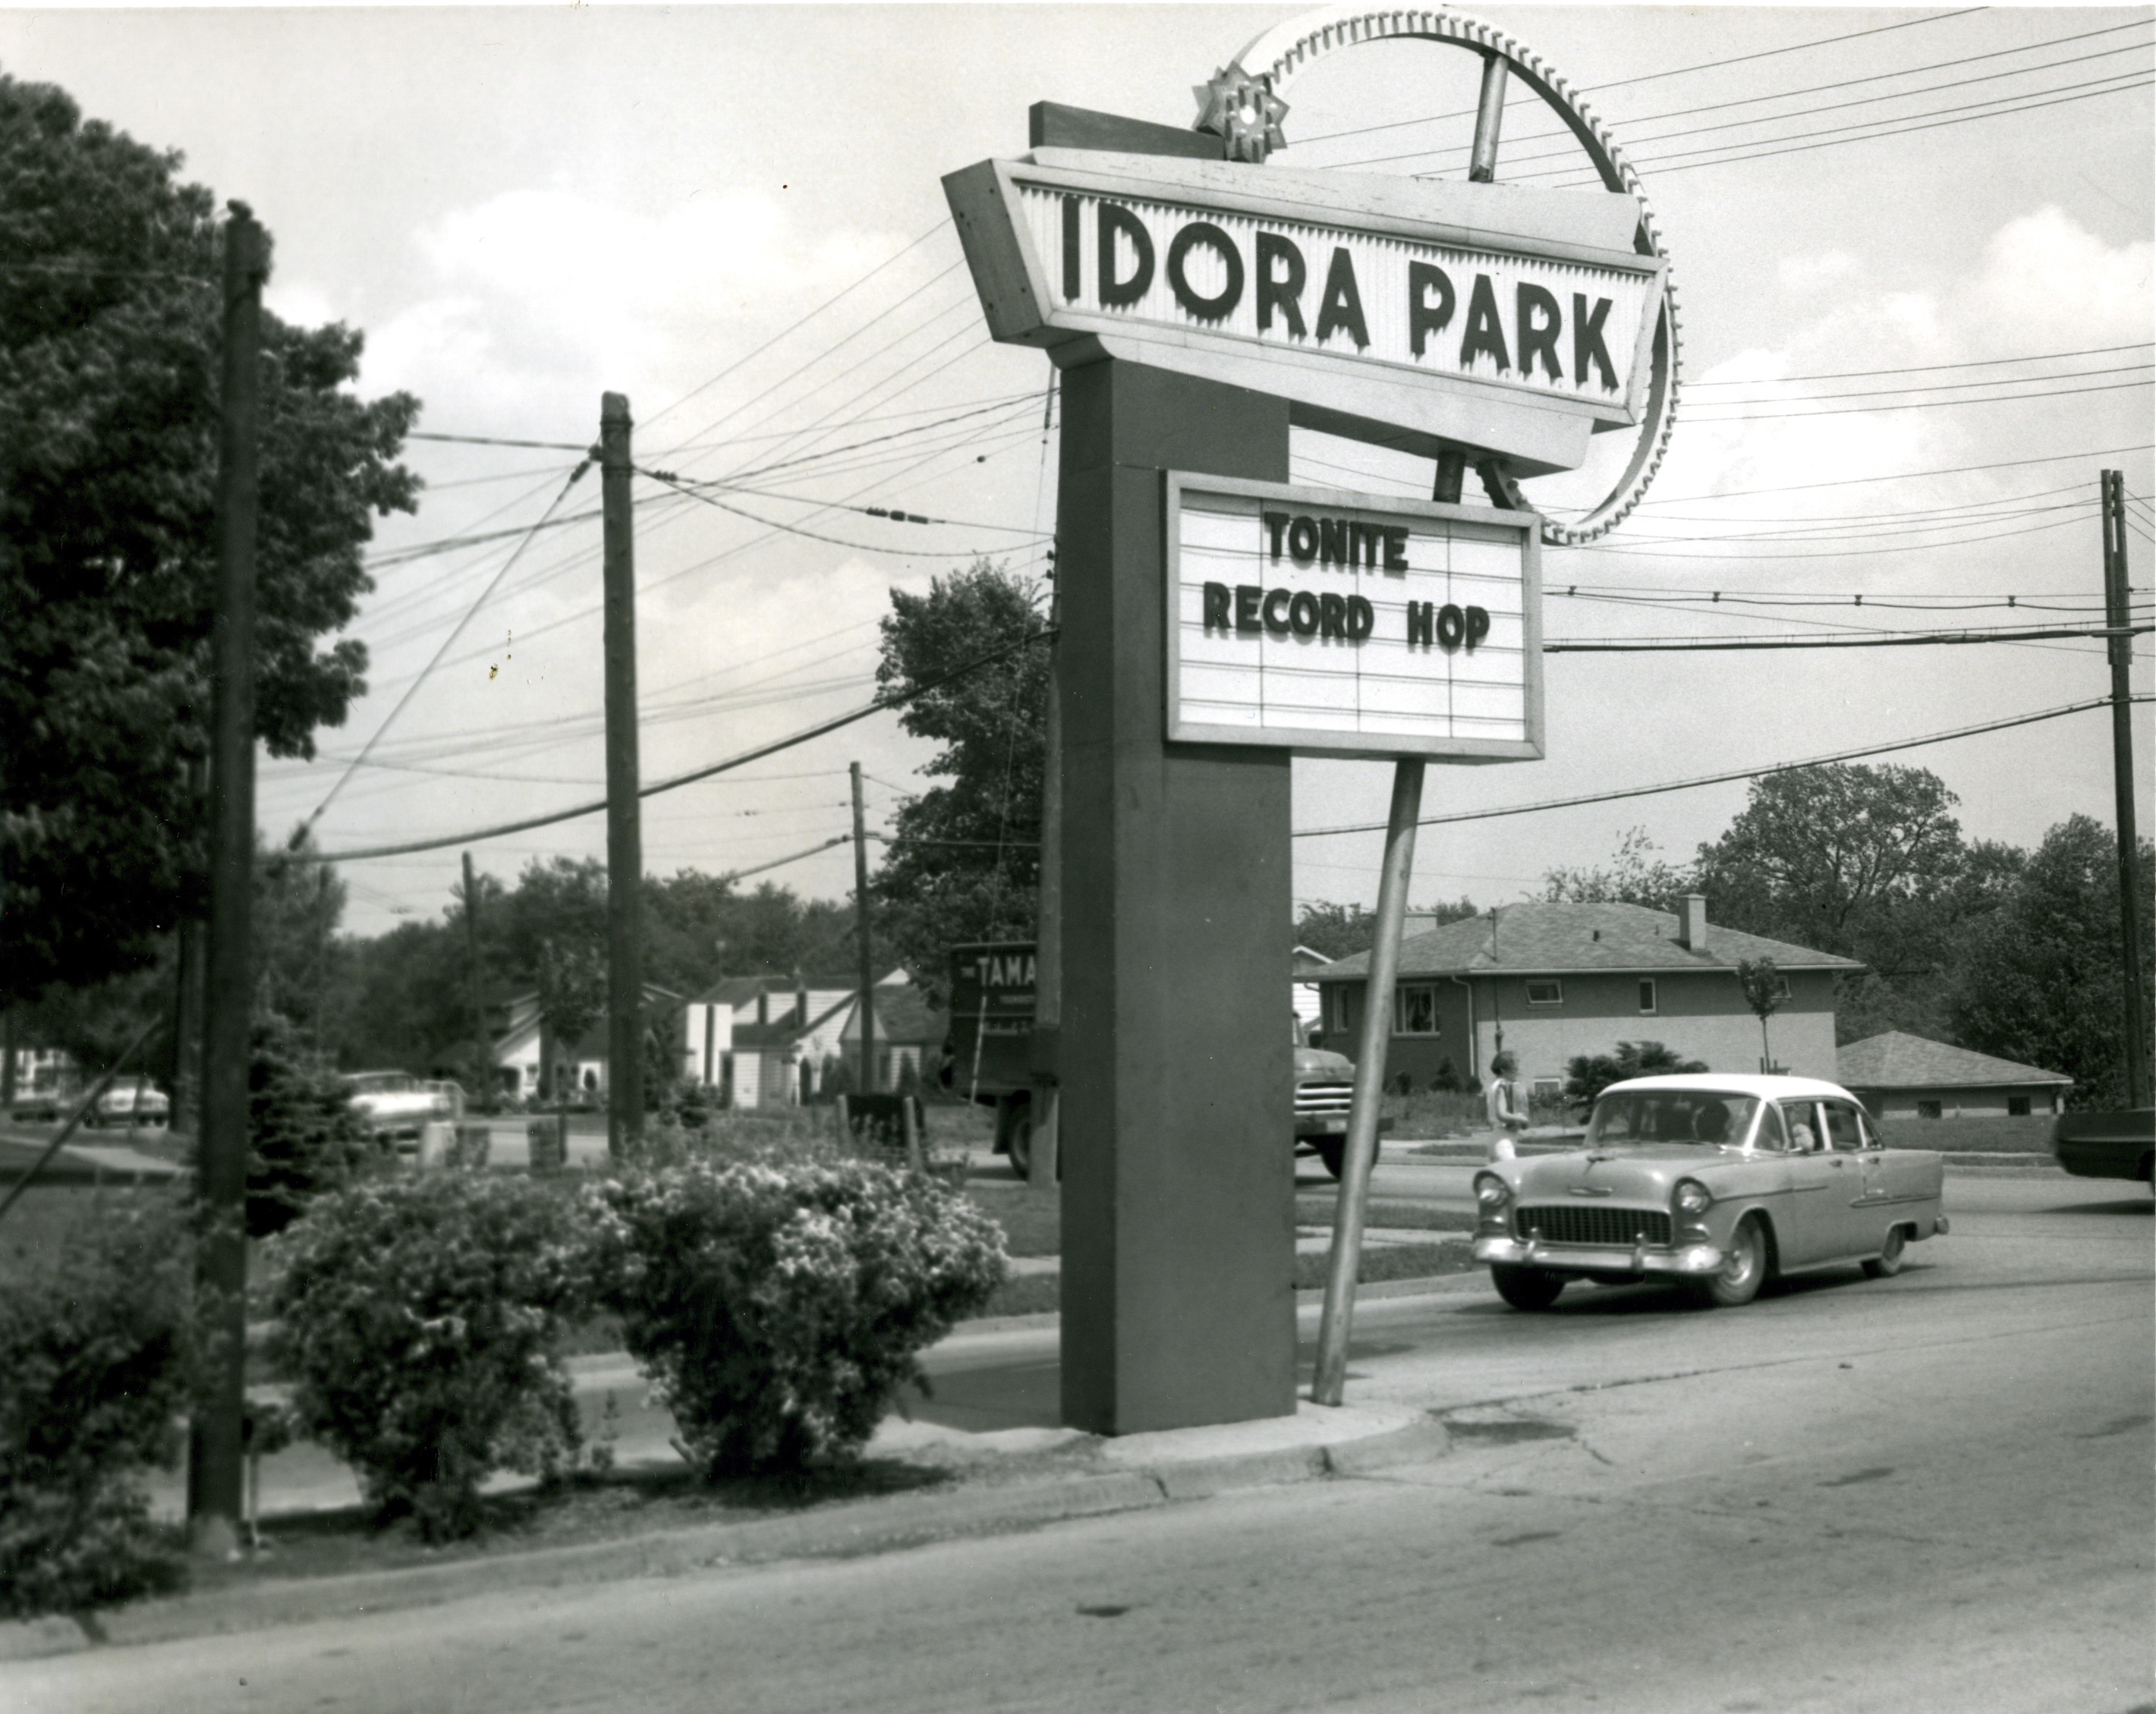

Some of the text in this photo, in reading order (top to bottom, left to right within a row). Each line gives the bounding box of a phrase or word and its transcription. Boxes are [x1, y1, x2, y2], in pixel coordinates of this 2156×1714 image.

[1061, 194, 1619, 389] IDORA PARK
[1264, 511, 1409, 571] TONITE
[1203, 581, 1490, 649] RECORD HOP
